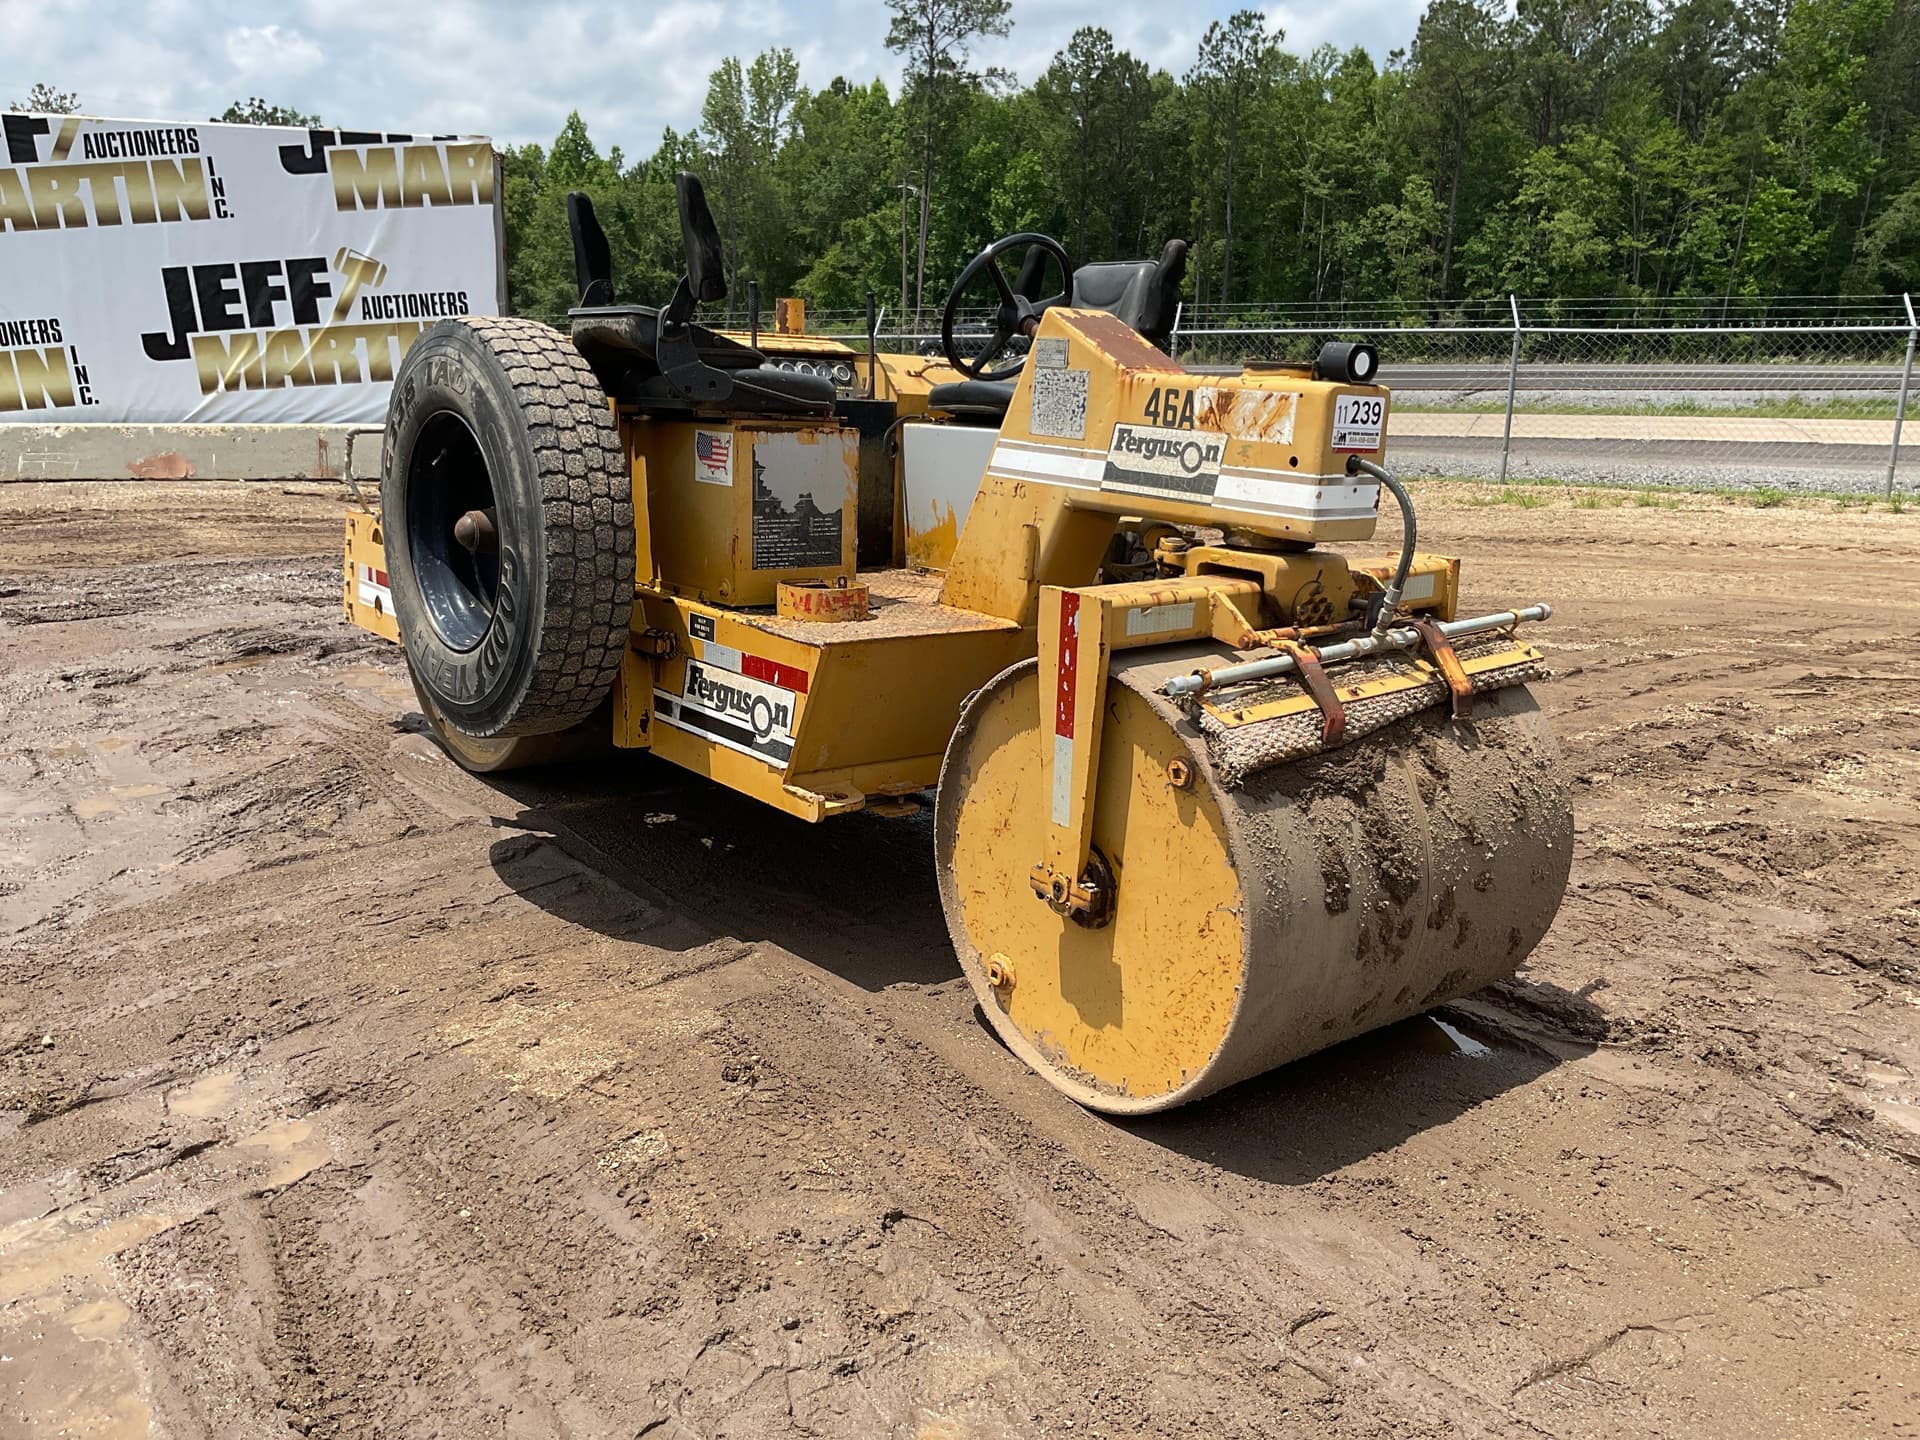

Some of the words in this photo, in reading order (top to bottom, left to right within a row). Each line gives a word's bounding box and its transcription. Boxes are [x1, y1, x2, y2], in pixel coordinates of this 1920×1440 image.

[83, 128, 200, 159] AUCTIONEERS
[140, 257, 332, 361] JEFF
[361, 291, 470, 320] AUCTIONEERS
[192, 321, 434, 395] MART
[1144, 387, 1195, 430] 46A
[1350, 400, 1382, 425] 239
